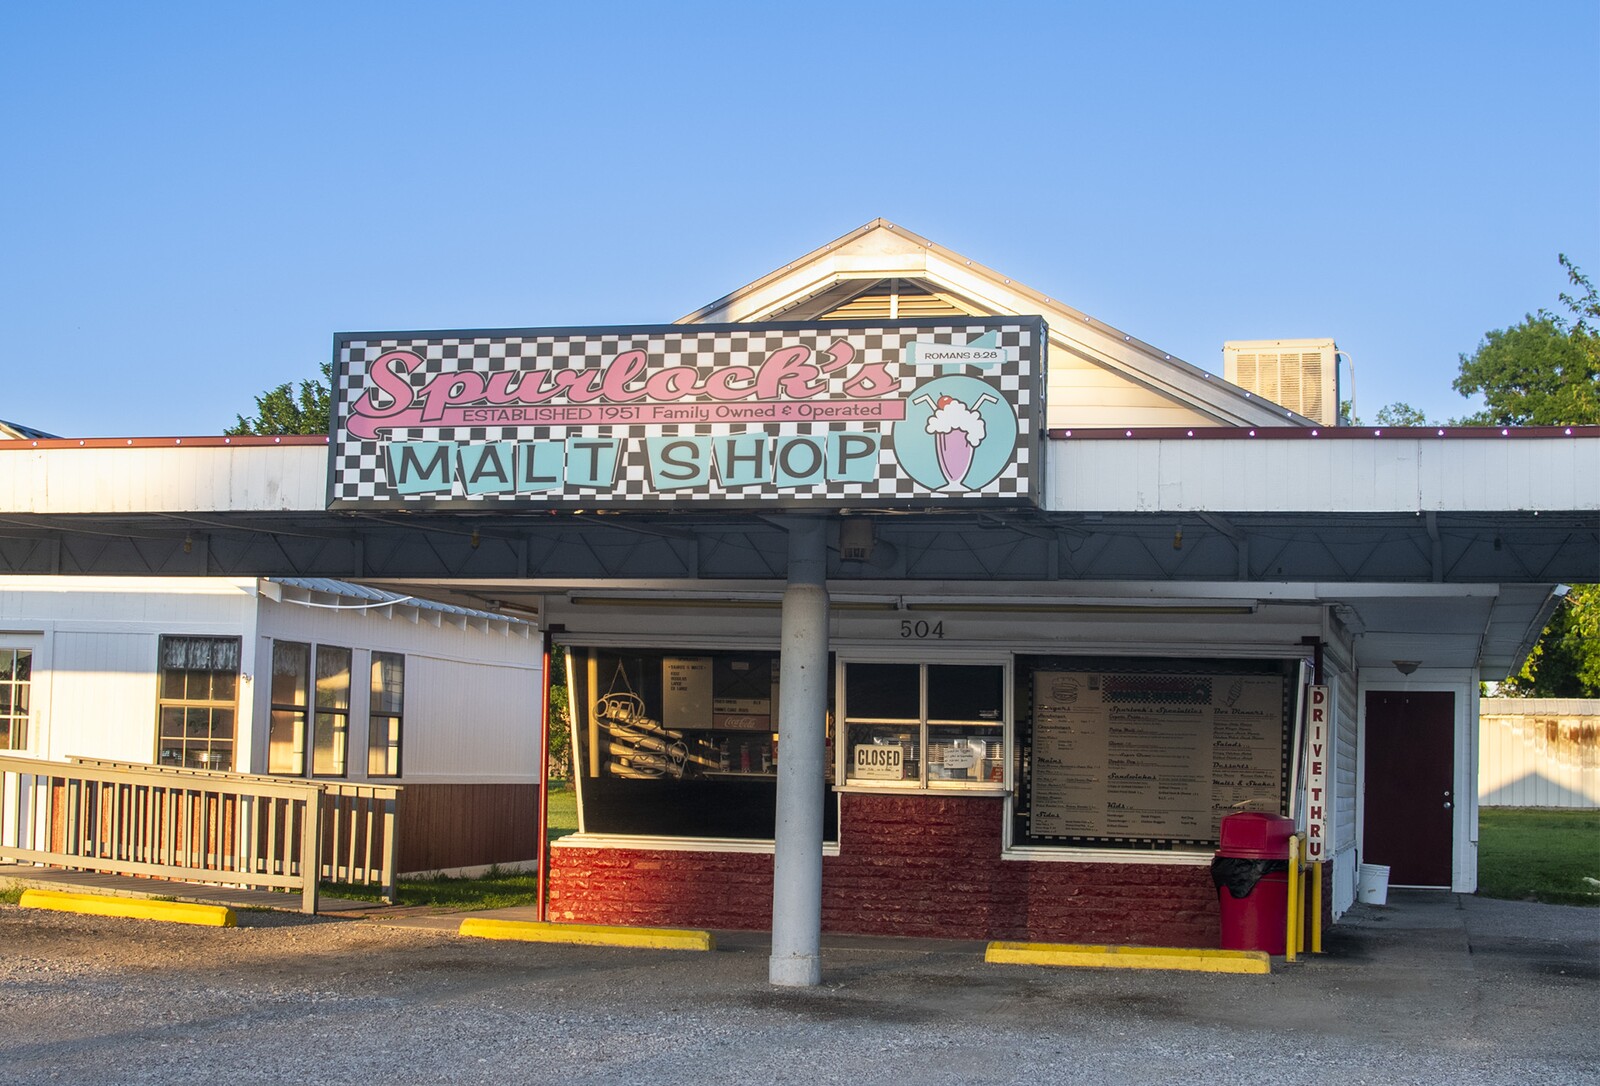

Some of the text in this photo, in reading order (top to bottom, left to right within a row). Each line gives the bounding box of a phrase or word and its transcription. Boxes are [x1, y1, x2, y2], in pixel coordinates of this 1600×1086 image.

[924, 351, 998, 360] ROMANS 8:28
[350, 338, 902, 423] Spurlock's
[462, 407, 593, 422] ESTABLISHED
[599, 406, 641, 421] 1951
[652, 406, 710, 422] Family
[715, 404, 776, 419] Owned
[797, 402, 882, 420] Operated
[398, 434, 877, 484] MALT SHOP
[900, 620, 945, 639] 504
[857, 749, 900, 766] CLOSED
[1309, 690, 1325, 857] DRIVE THRU
